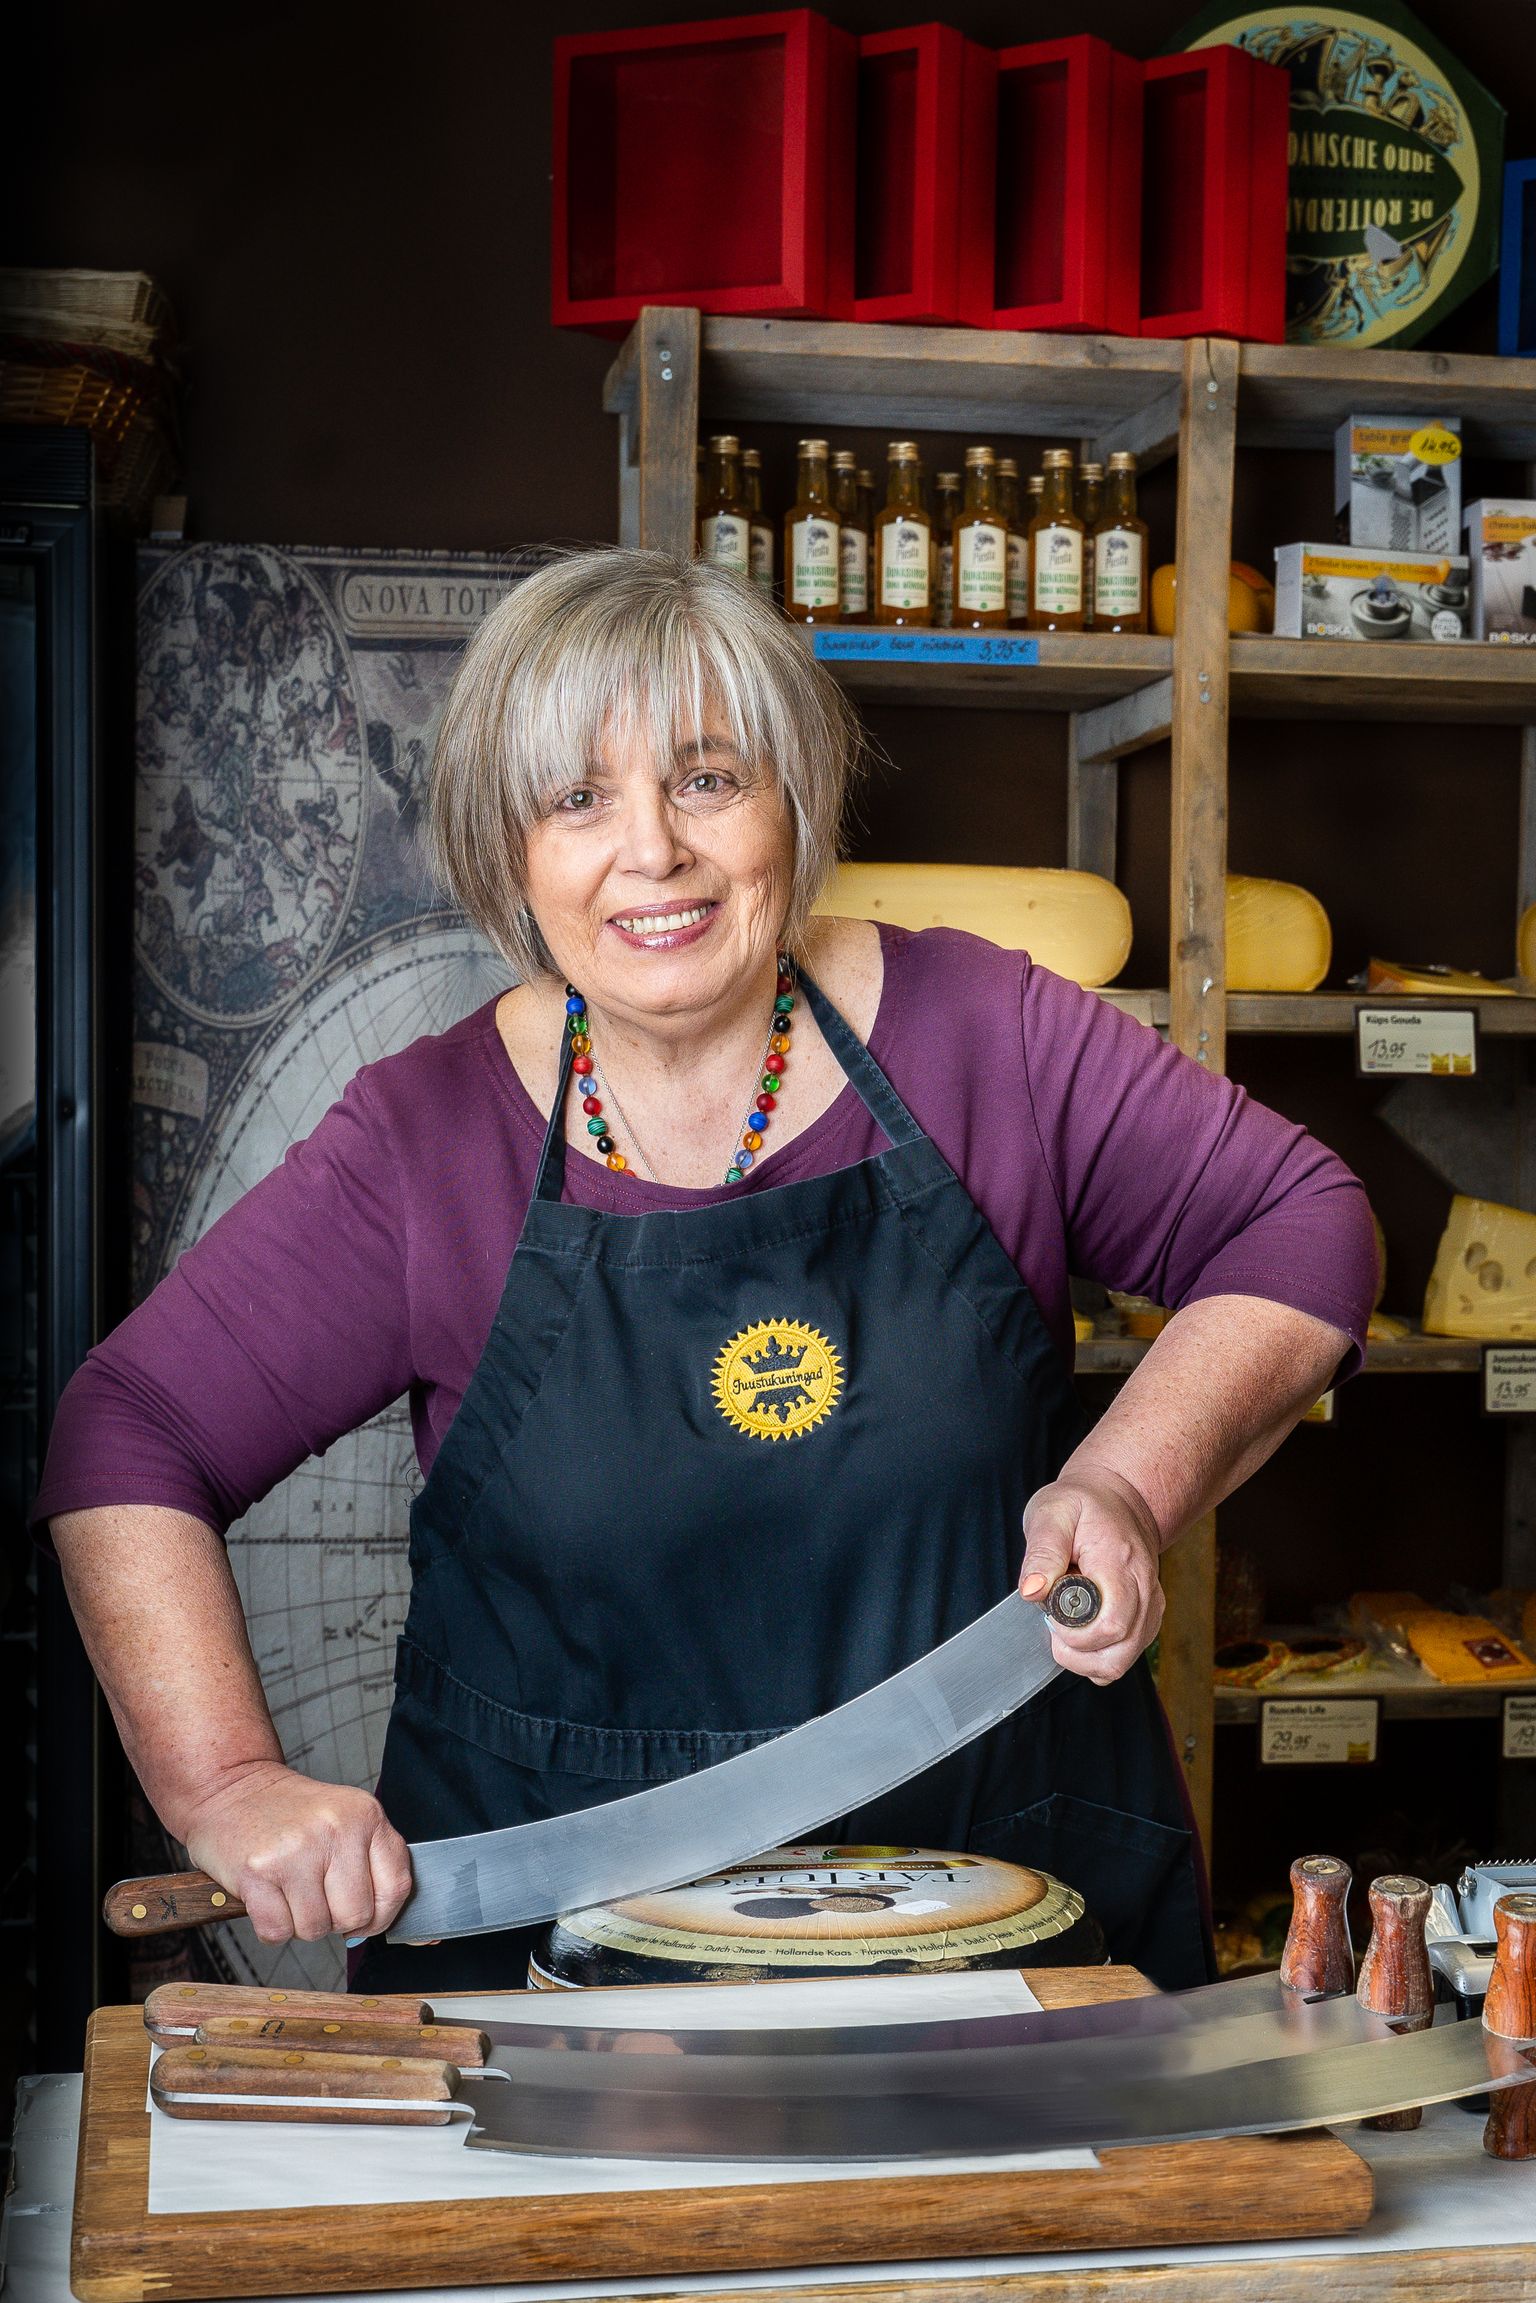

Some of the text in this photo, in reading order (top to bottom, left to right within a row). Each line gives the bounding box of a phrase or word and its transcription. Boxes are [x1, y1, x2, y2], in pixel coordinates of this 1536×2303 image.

[1383, 143, 1435, 173] OUDE
[1287, 198, 1434, 233] DE ROTTERDA
[356, 583, 431, 616] NOVA
[1390, 1015, 1422, 1025] Gouda
[1368, 1038, 1408, 1059] 13,95
[732, 1366, 823, 1395] Juustukuningad
[689, 1872, 972, 1889] TARTUFO
[659, 1939, 697, 1951] Hollande
[704, 1945, 730, 1954] Dutch
[732, 1945, 766, 1955] Cheese
[775, 1948, 825, 1957] Hollandse
[827, 1949, 852, 1957] Kaas
[861, 1948, 903, 1958] Fromage
[906, 1945, 918, 1954] de
[919, 1940, 958, 1953] Hollande
[966, 1935, 989, 1946] Dutch
